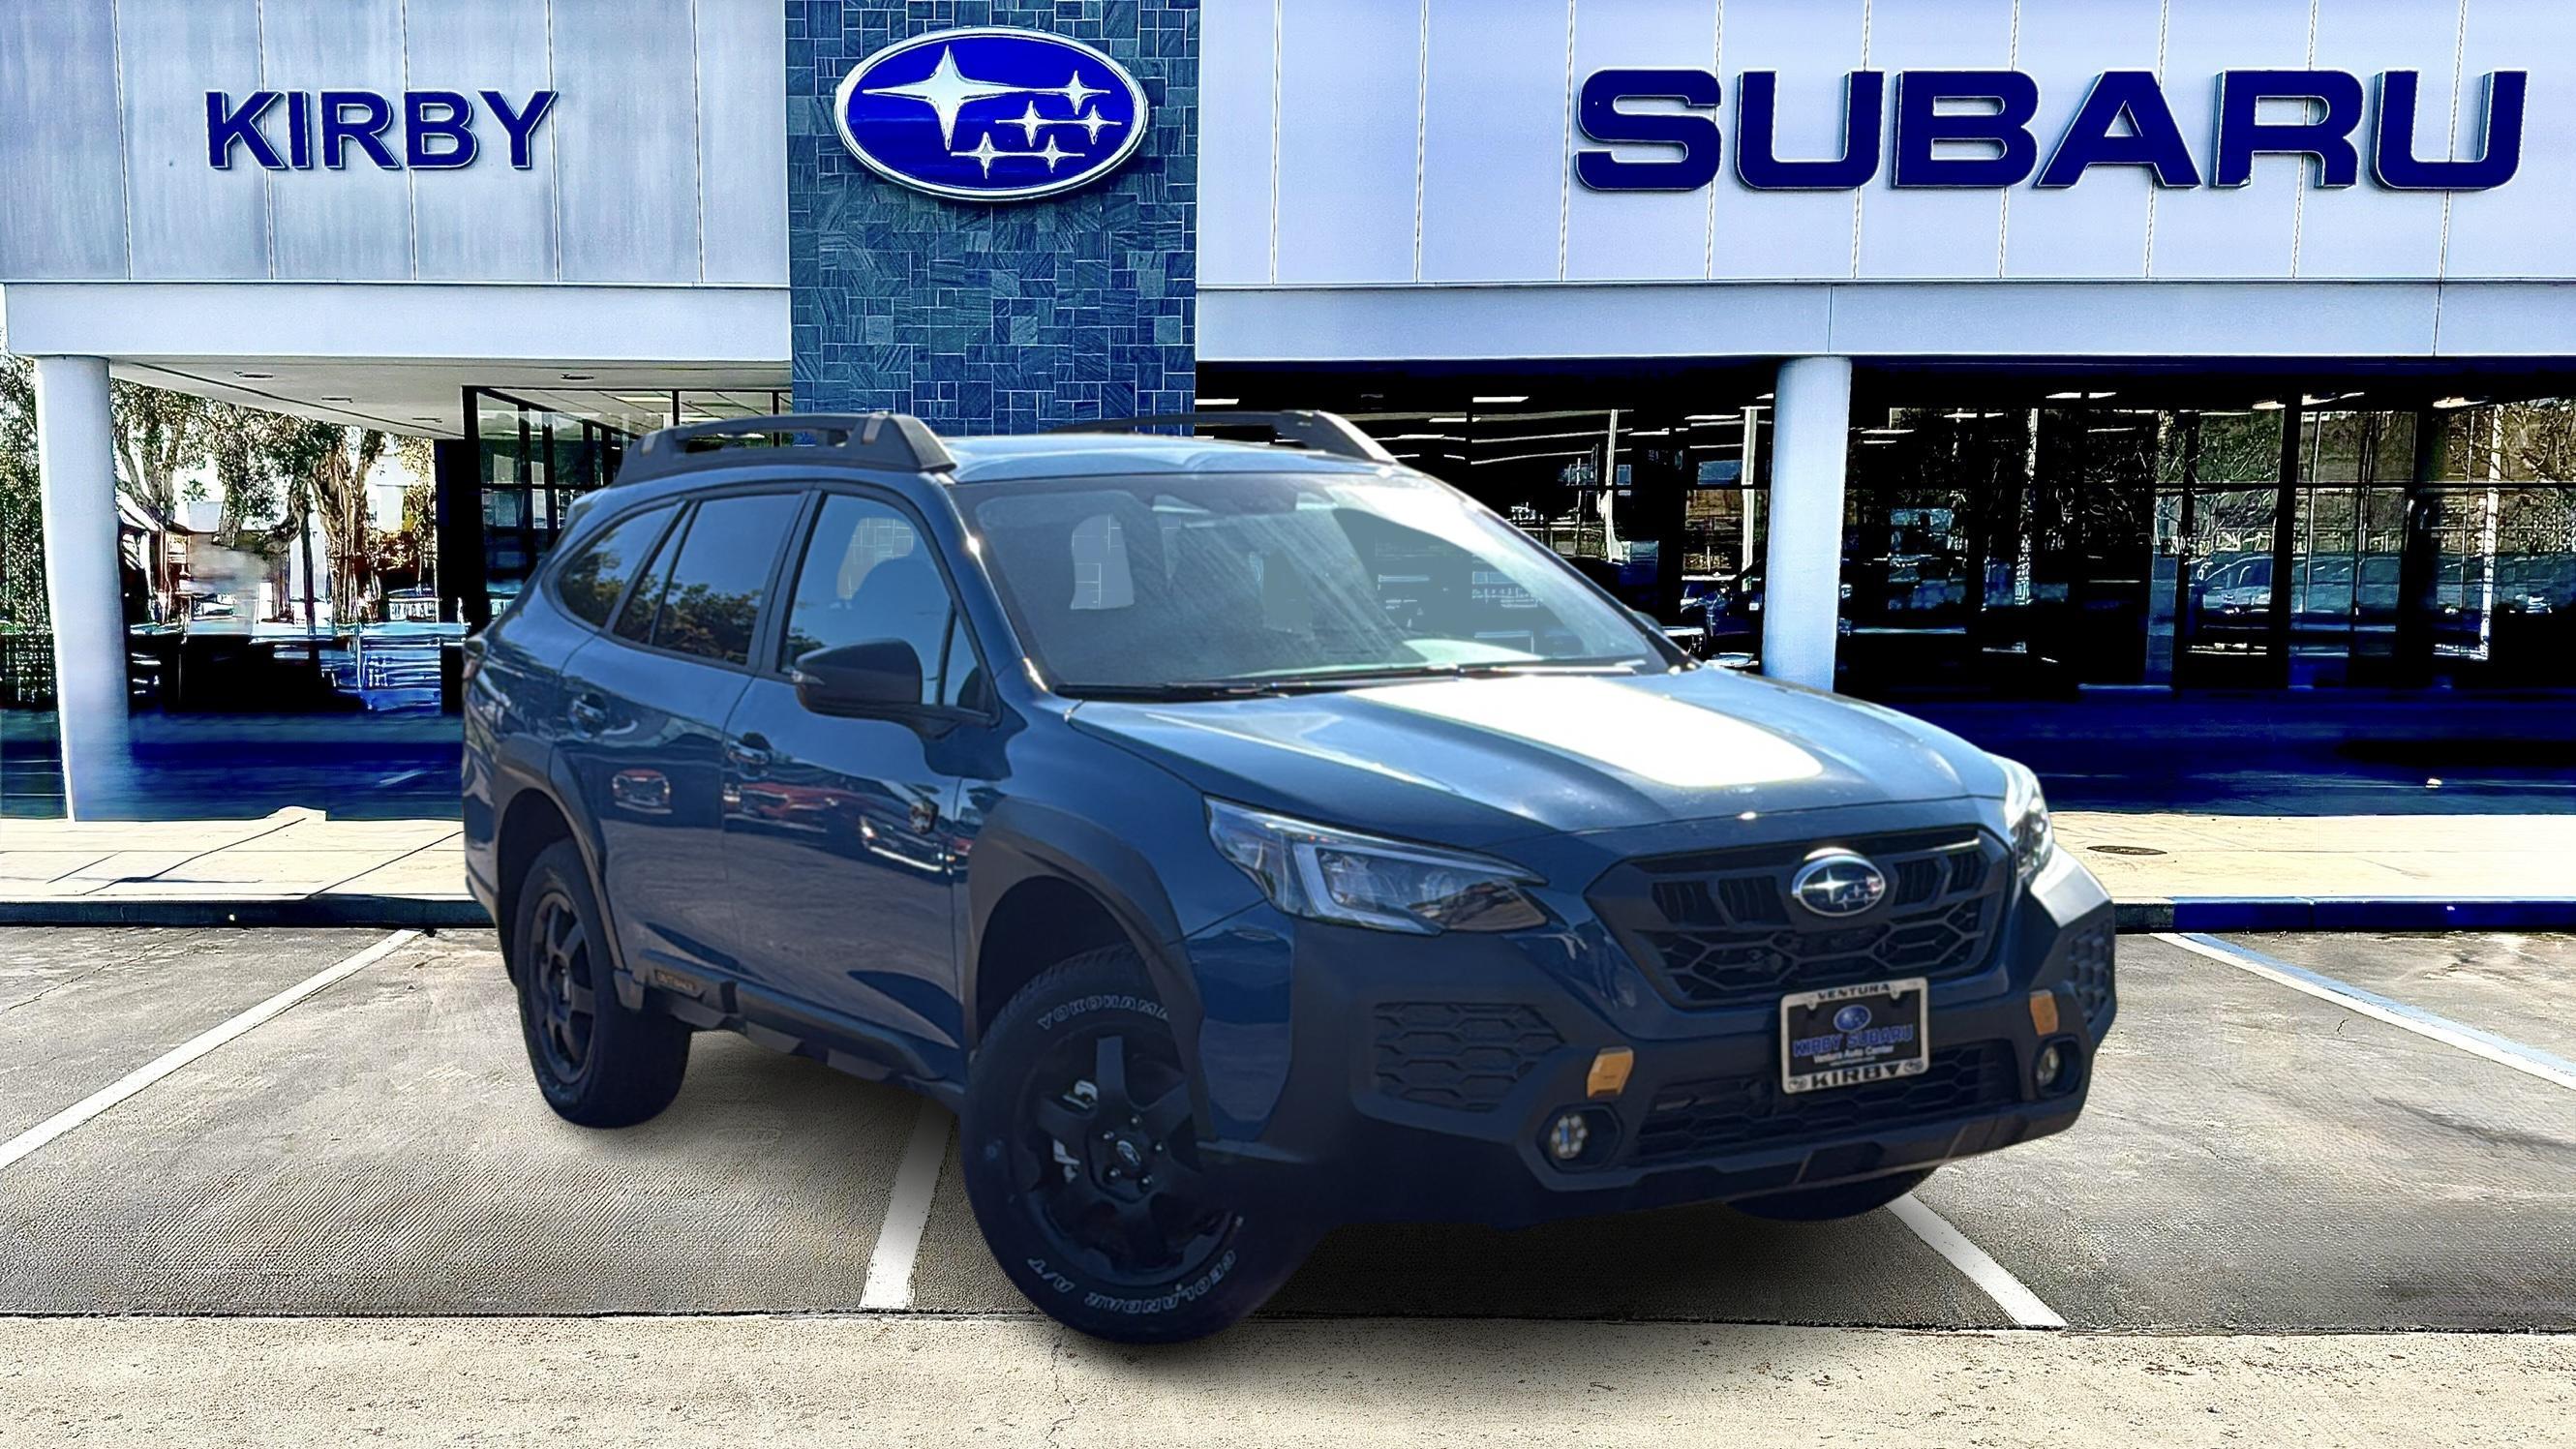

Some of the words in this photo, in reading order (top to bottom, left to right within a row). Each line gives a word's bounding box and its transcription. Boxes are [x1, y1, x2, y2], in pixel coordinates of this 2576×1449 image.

[206, 90, 558, 171] KIRBY
[1575, 68, 2526, 194] SUBARU
[1818, 983, 1891, 999] VENTURA
[1037, 995, 1169, 1030] YOKOHAMA
[1794, 1034, 1843, 1057] KIRBY
[1846, 1025, 1913, 1048] SUBARU
[1812, 1065, 1900, 1088] KIRBY
[1084, 1250, 1237, 1313] GEOLANDAR
